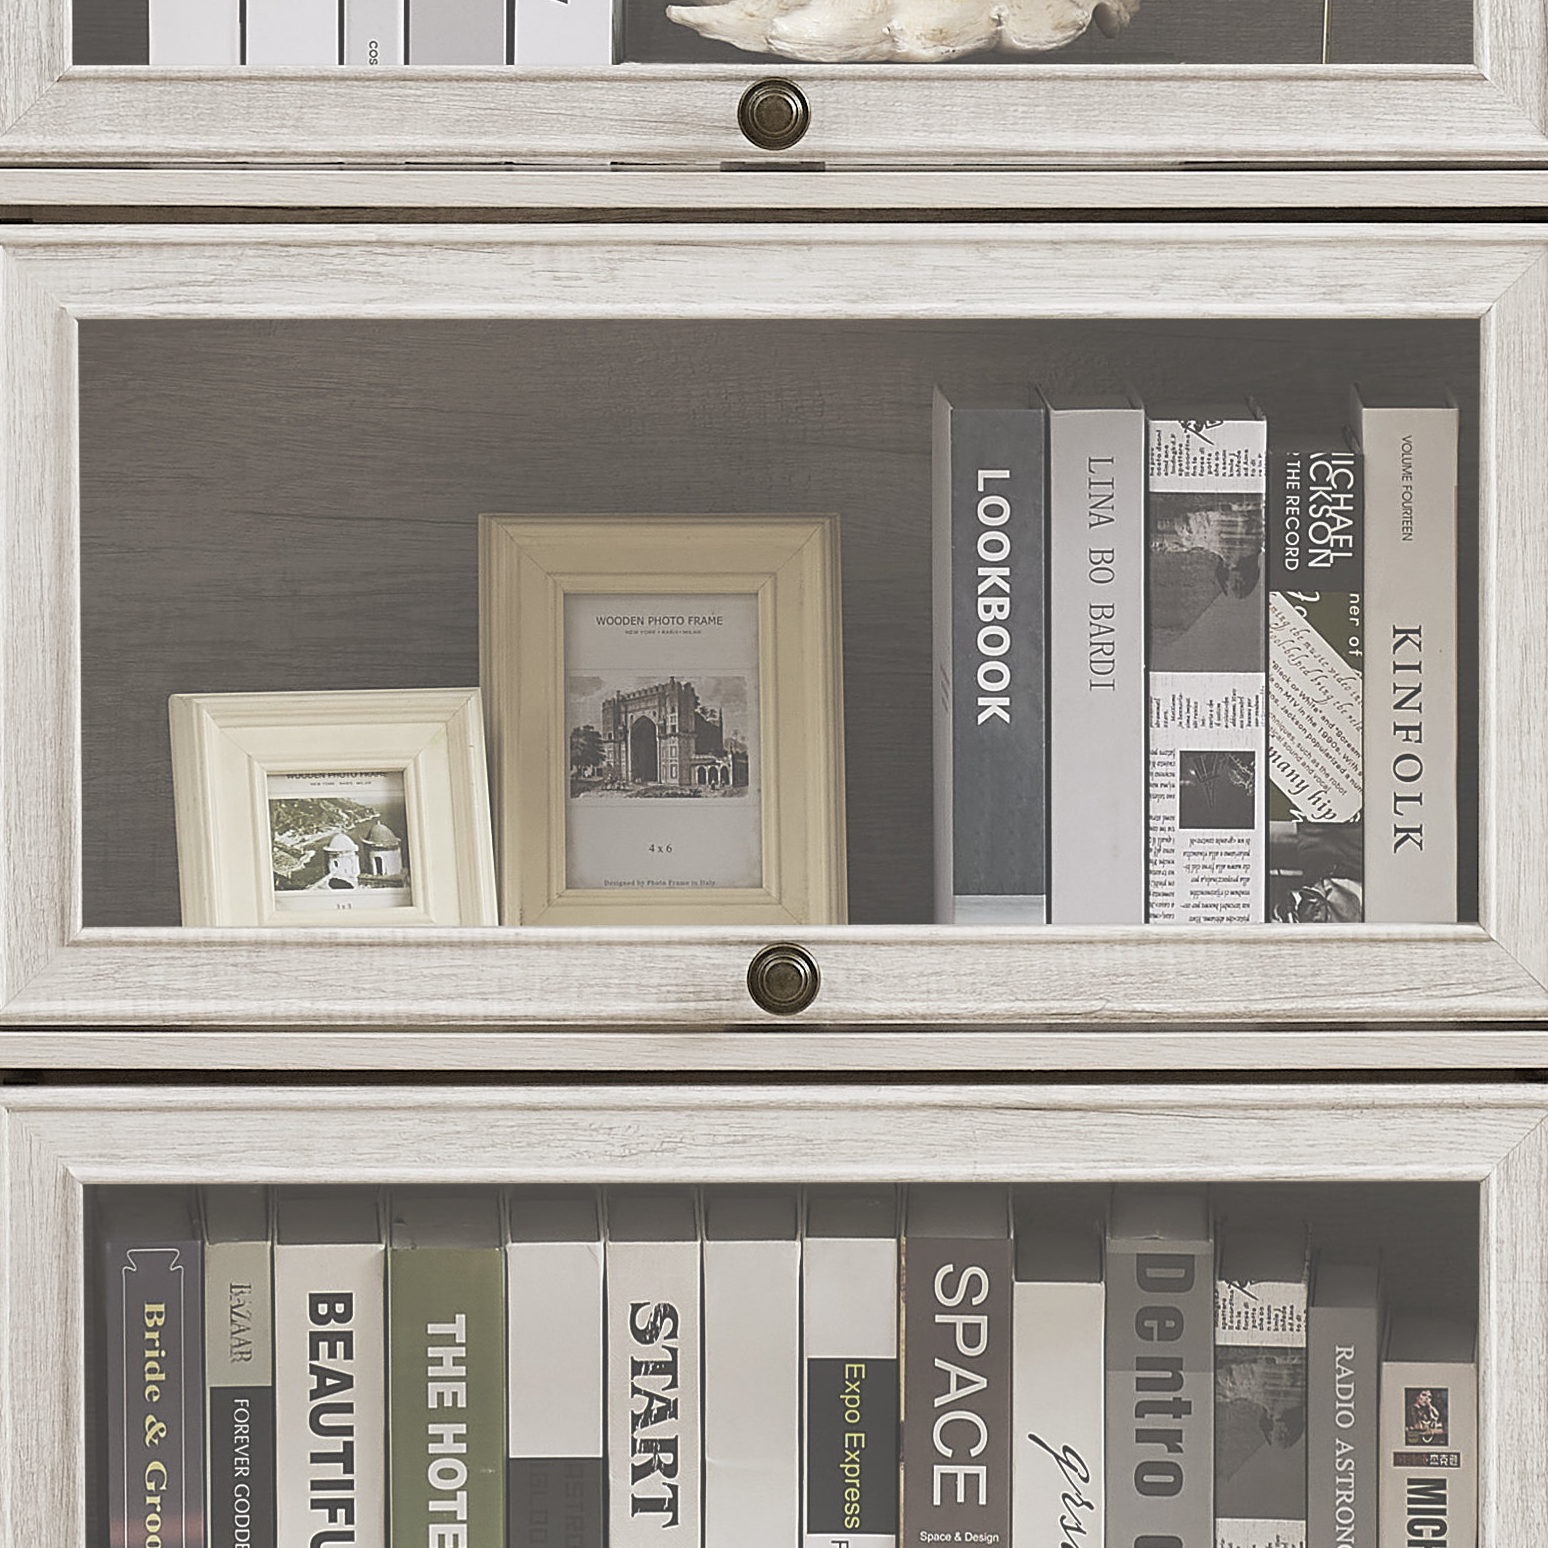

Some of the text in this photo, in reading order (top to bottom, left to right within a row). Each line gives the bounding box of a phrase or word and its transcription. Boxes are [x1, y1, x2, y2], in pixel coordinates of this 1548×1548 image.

[1286, 461, 1300, 490] THE
[1330, 452, 1354, 564] ICHAEL
[1402, 435, 1413, 541] VOLUME FOURTEEN
[1285, 496, 1300, 571] RECORD
[977, 470, 1010, 725] LOOKBOOK
[1089, 457, 1115, 690] LINA BO BARDI
[596, 616, 723, 625] WOODEN PHOTO FRAME
[1349, 594, 1362, 656] ner of
[1274, 683, 1283, 692] on
[1283, 691, 1299, 707] MTV
[1298, 707, 1305, 716] in
[1306, 715, 1317, 727] the
[1343, 753, 1358, 772] With
[1281, 706, 1307, 734] Jackson
[1305, 733, 1347, 774] popularized
[1321, 716, 1335, 729] and
[1393, 625, 1423, 853] KINFOLK
[1283, 742, 1302, 762] sound
[1301, 762, 1314, 775] and
[1314, 774, 1331, 792] vocal
[1297, 743, 1311, 759] such
[1311, 759, 1319, 767] as
[1319, 766, 1330, 778] the
[1329, 778, 1347, 795] robot
[1308, 789, 1337, 821] hip
[649, 844, 655, 852] 4
[666, 844, 672, 852] 6
[145, 1304, 165, 1401] Bride
[428, 1314, 466, 1408] THE
[933, 1264, 988, 1505] SPACE
[1133, 1253, 1196, 1498] Dentro
[1336, 1346, 1354, 1428] RADIO
[146, 1415, 166, 1447] &
[234, 1400, 249, 1476] FOREVER
[629, 1300, 680, 1530] START
[840, 1364, 865, 1528] Expo Express
[920, 1531, 999, 1544] Space & Design
